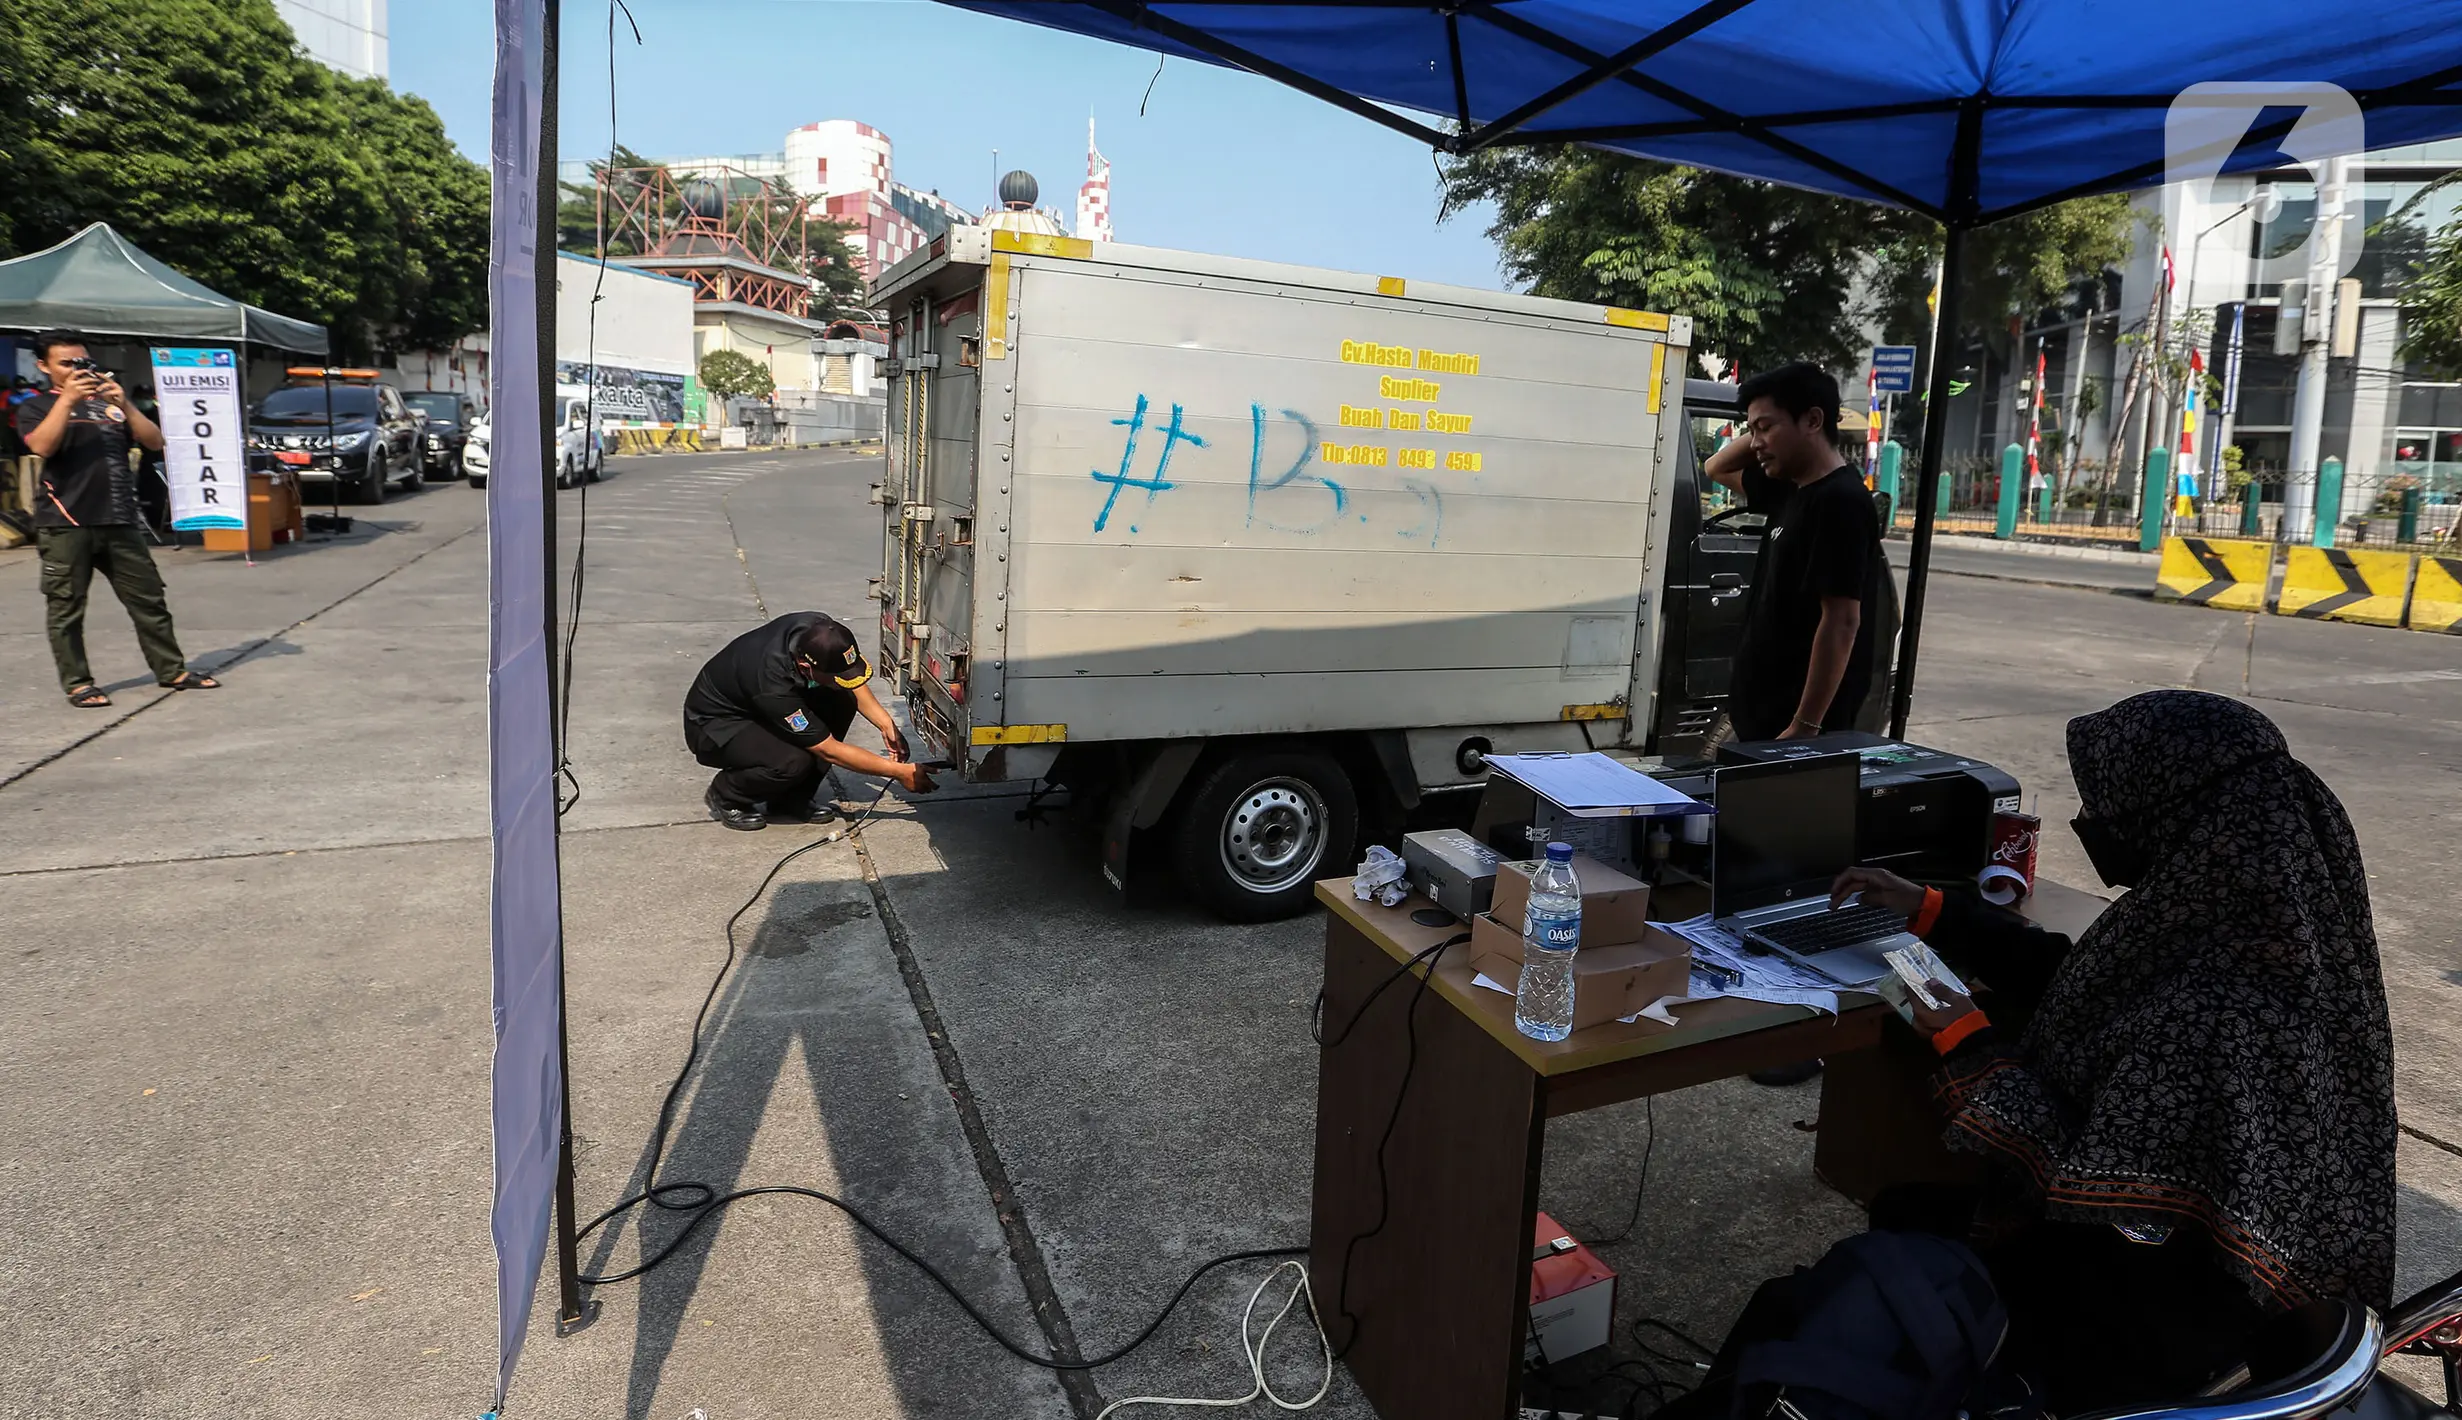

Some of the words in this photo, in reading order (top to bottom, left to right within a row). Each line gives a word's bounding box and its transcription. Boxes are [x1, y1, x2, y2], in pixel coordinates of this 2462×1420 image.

[1340, 339, 1413, 369] Cv.Hasta
[1417, 349, 1480, 376] Mandiri
[163, 375, 185, 386] UJI
[189, 375, 230, 387] EMISI
[1380, 375, 1441, 403] Suplier
[1339, 403, 1383, 429] Buah
[1388, 407, 1421, 431] Dan
[1426, 408, 1473, 434] Sayur
[193, 399, 219, 504] SOLAR
[1445, 451, 1482, 471] 459
